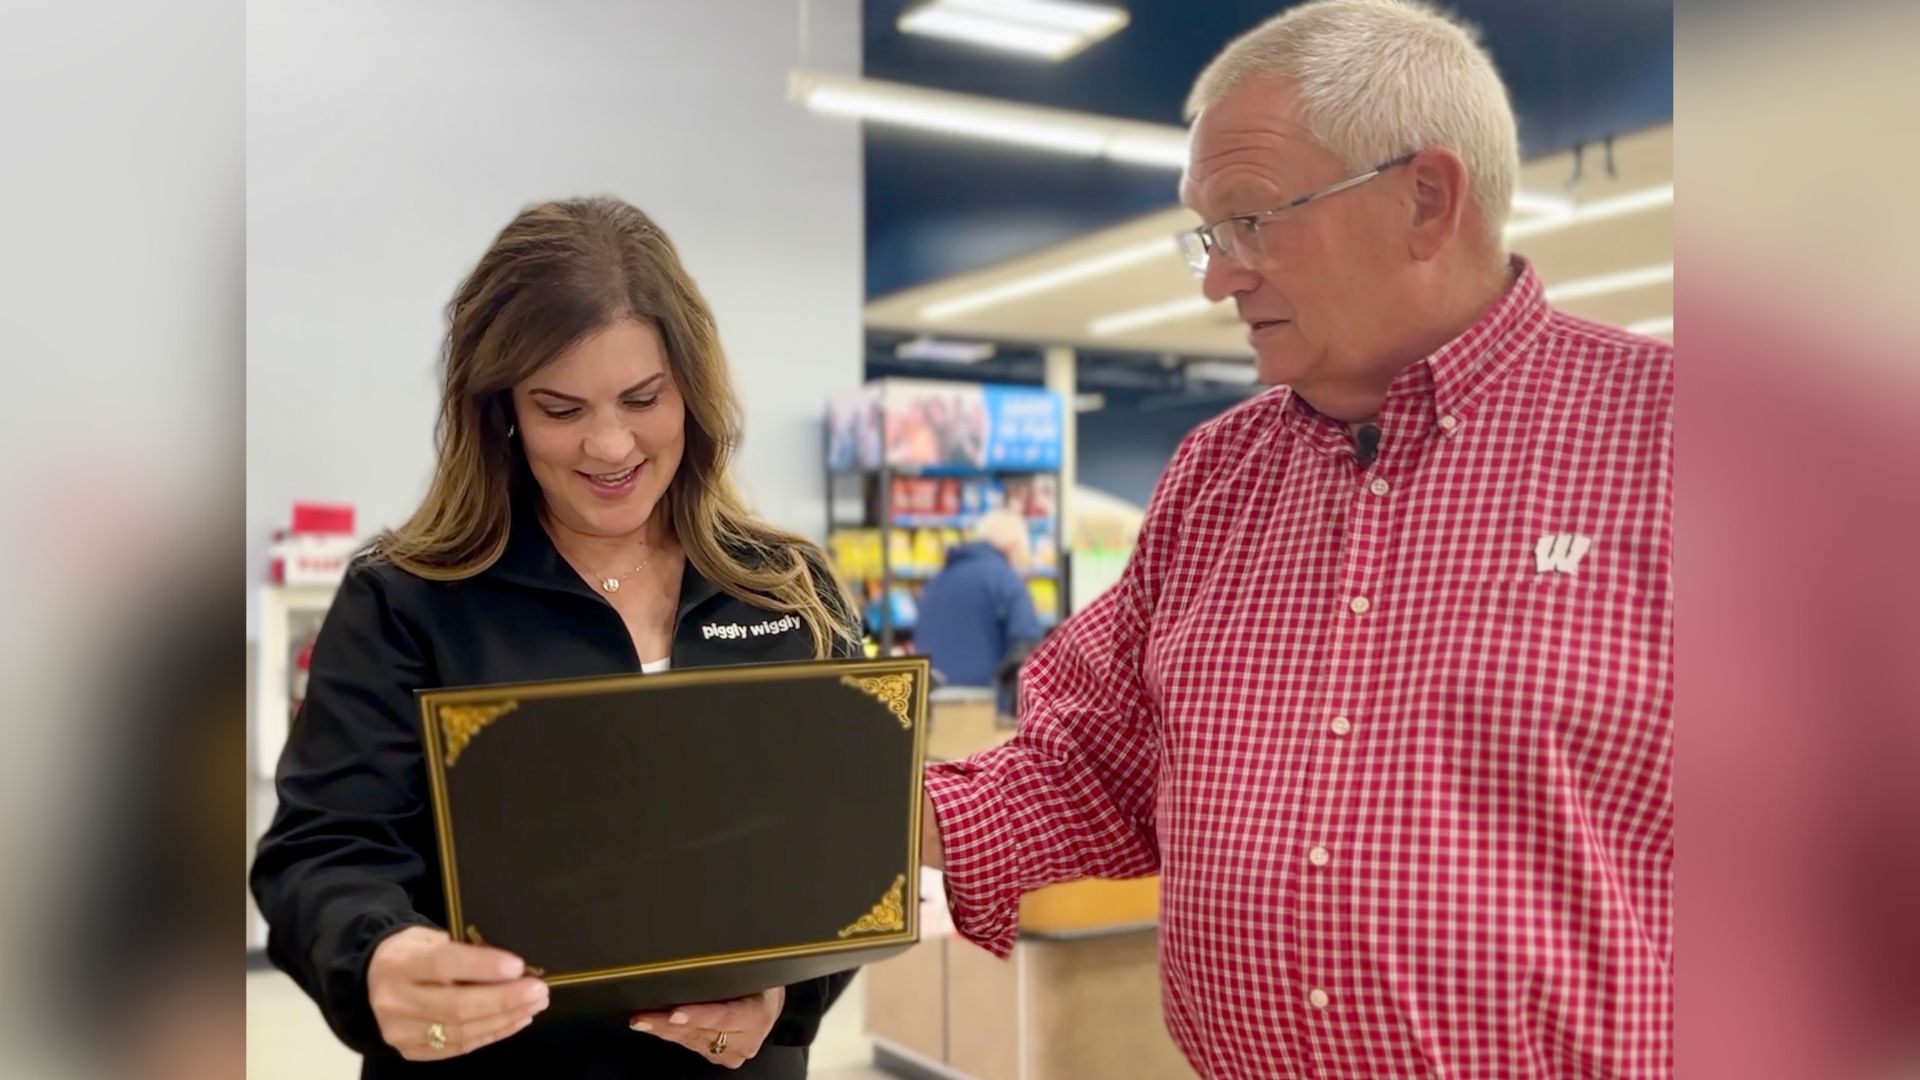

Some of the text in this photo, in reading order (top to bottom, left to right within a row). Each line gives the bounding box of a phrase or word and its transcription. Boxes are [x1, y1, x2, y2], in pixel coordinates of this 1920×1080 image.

[1535, 533, 1591, 574] W
[702, 614, 800, 640] piggly wiggly
